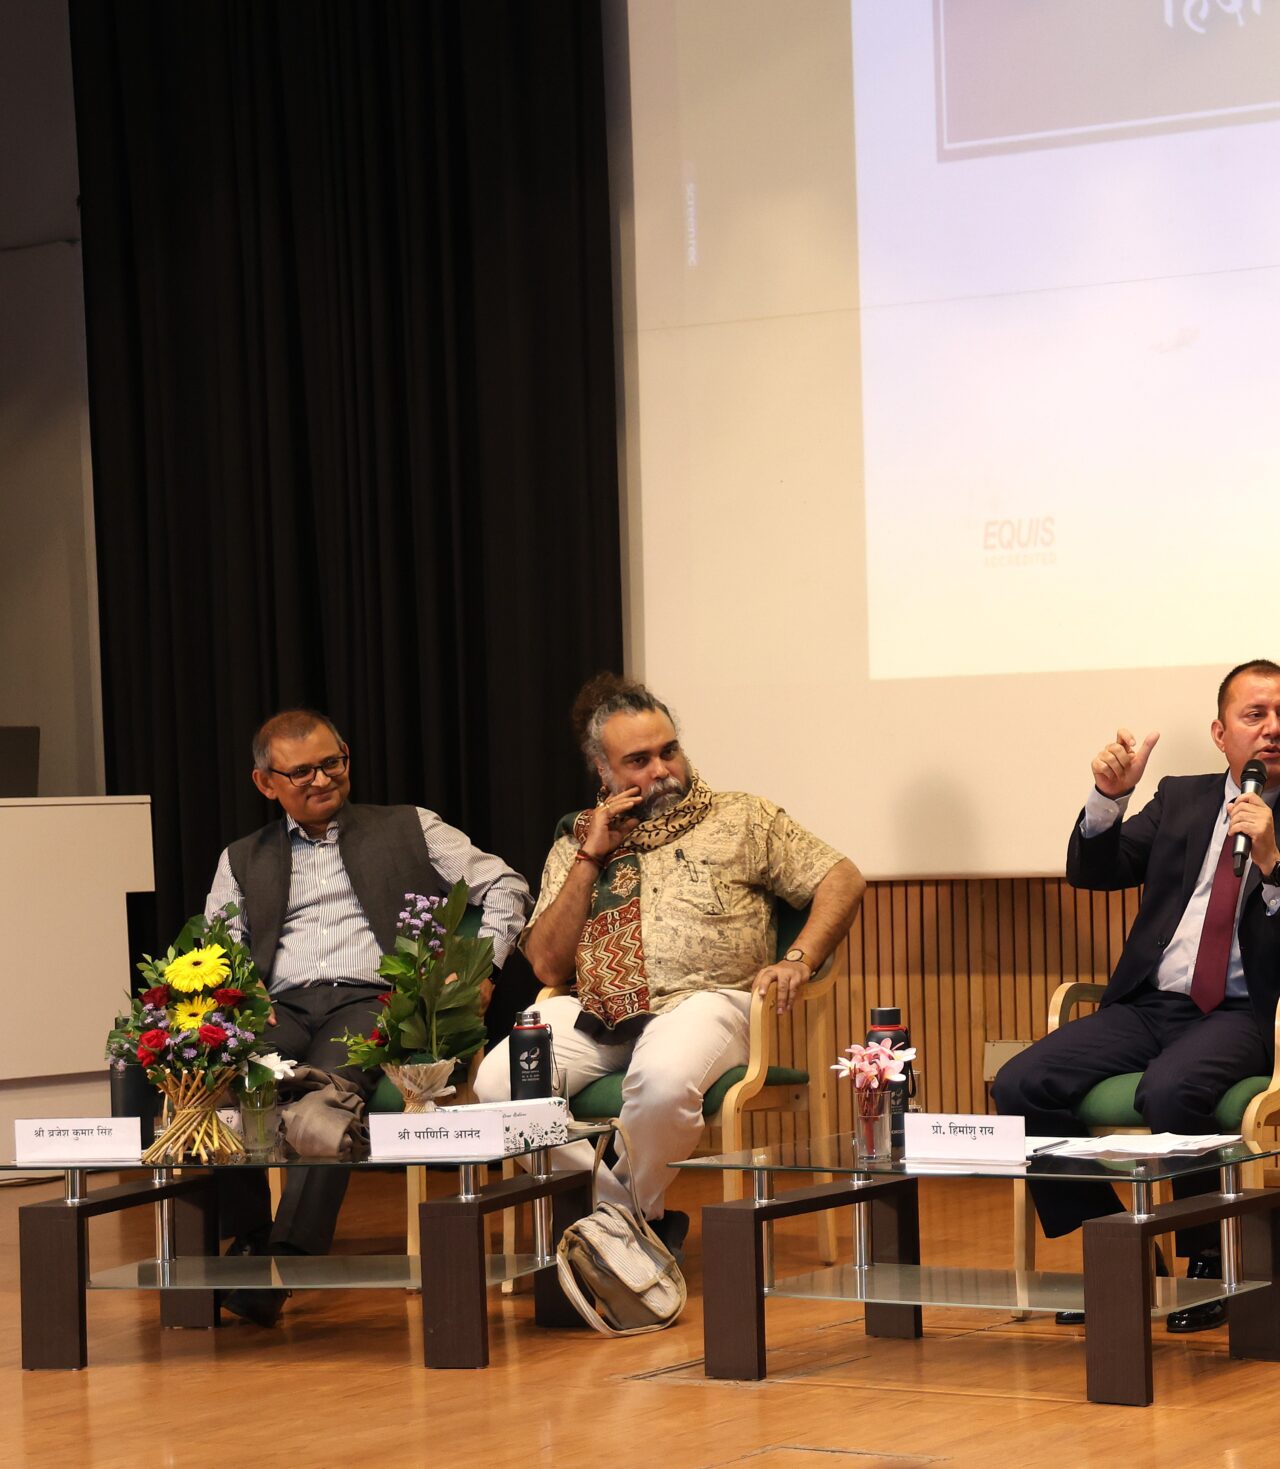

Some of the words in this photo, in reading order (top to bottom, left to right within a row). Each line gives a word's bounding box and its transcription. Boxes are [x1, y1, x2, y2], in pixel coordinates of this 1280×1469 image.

[983, 515, 1057, 550] EQUIS
[34, 1127, 45, 1138] श्री
[72, 1128, 95, 1141] कुमार
[97, 1125, 113, 1137] सिंह
[398, 1127, 411, 1140] श्री
[414, 1127, 449, 1140] पाणिनि
[454, 1127, 481, 1140] आनंद
[931, 1122, 946, 1135] प्रो.
[948, 1123, 977, 1140] हिमांशु
[979, 1125, 995, 1136] राय
